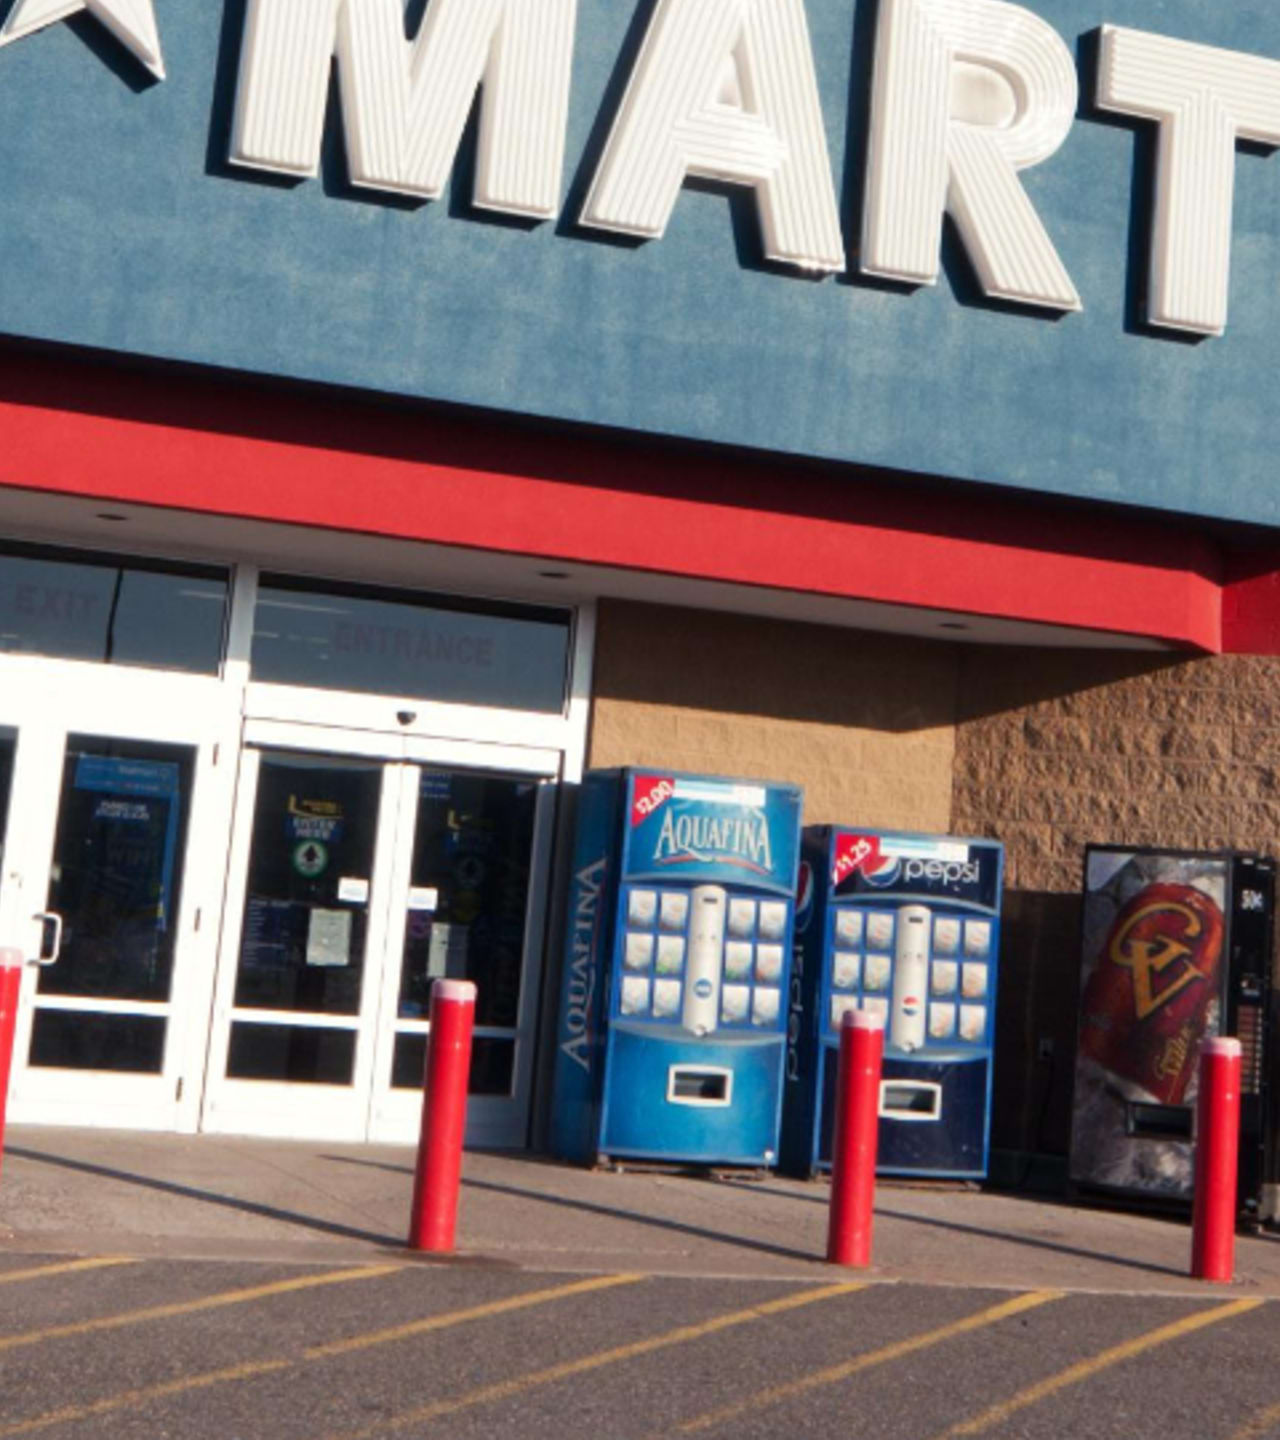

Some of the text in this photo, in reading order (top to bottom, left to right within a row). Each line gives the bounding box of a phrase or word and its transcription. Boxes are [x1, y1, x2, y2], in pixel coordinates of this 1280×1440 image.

[14, 583, 97, 621] EXIT
[333, 620, 496, 667] ENTRANCE
[653, 806, 772, 871] AQUAFINA
[904, 859, 980, 886] pepsi
[560, 858, 607, 1072] AQUAFINA
